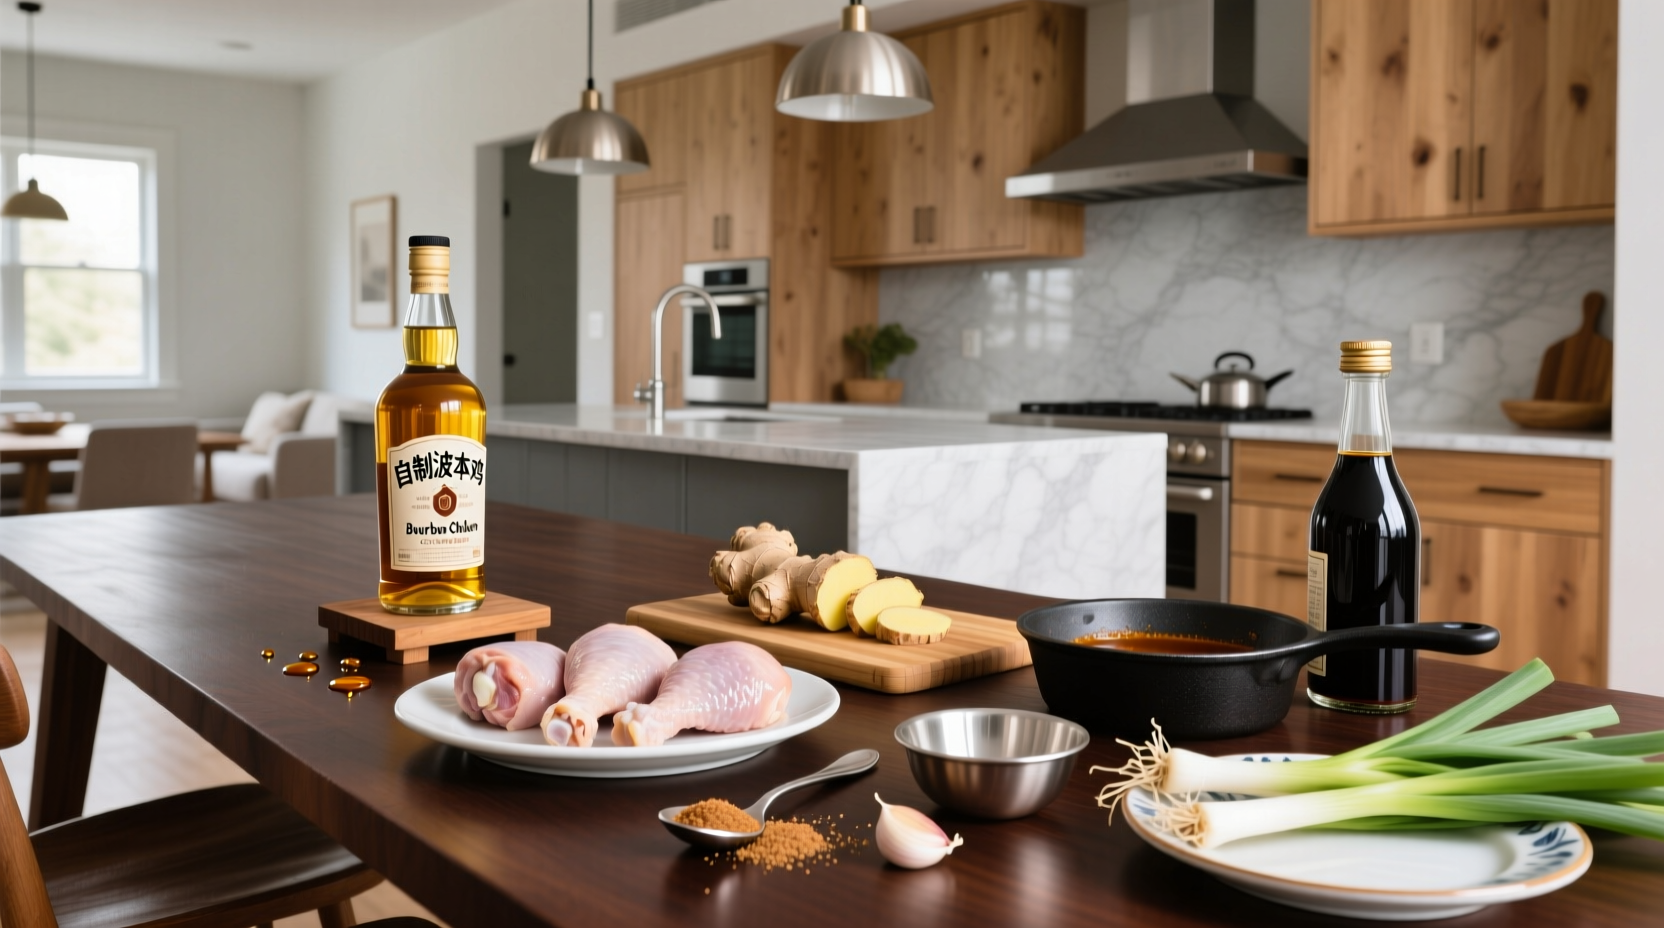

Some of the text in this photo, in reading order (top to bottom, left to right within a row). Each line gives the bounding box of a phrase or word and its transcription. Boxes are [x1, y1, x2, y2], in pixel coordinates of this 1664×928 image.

[394, 450, 484, 489] 自制波本鸡
